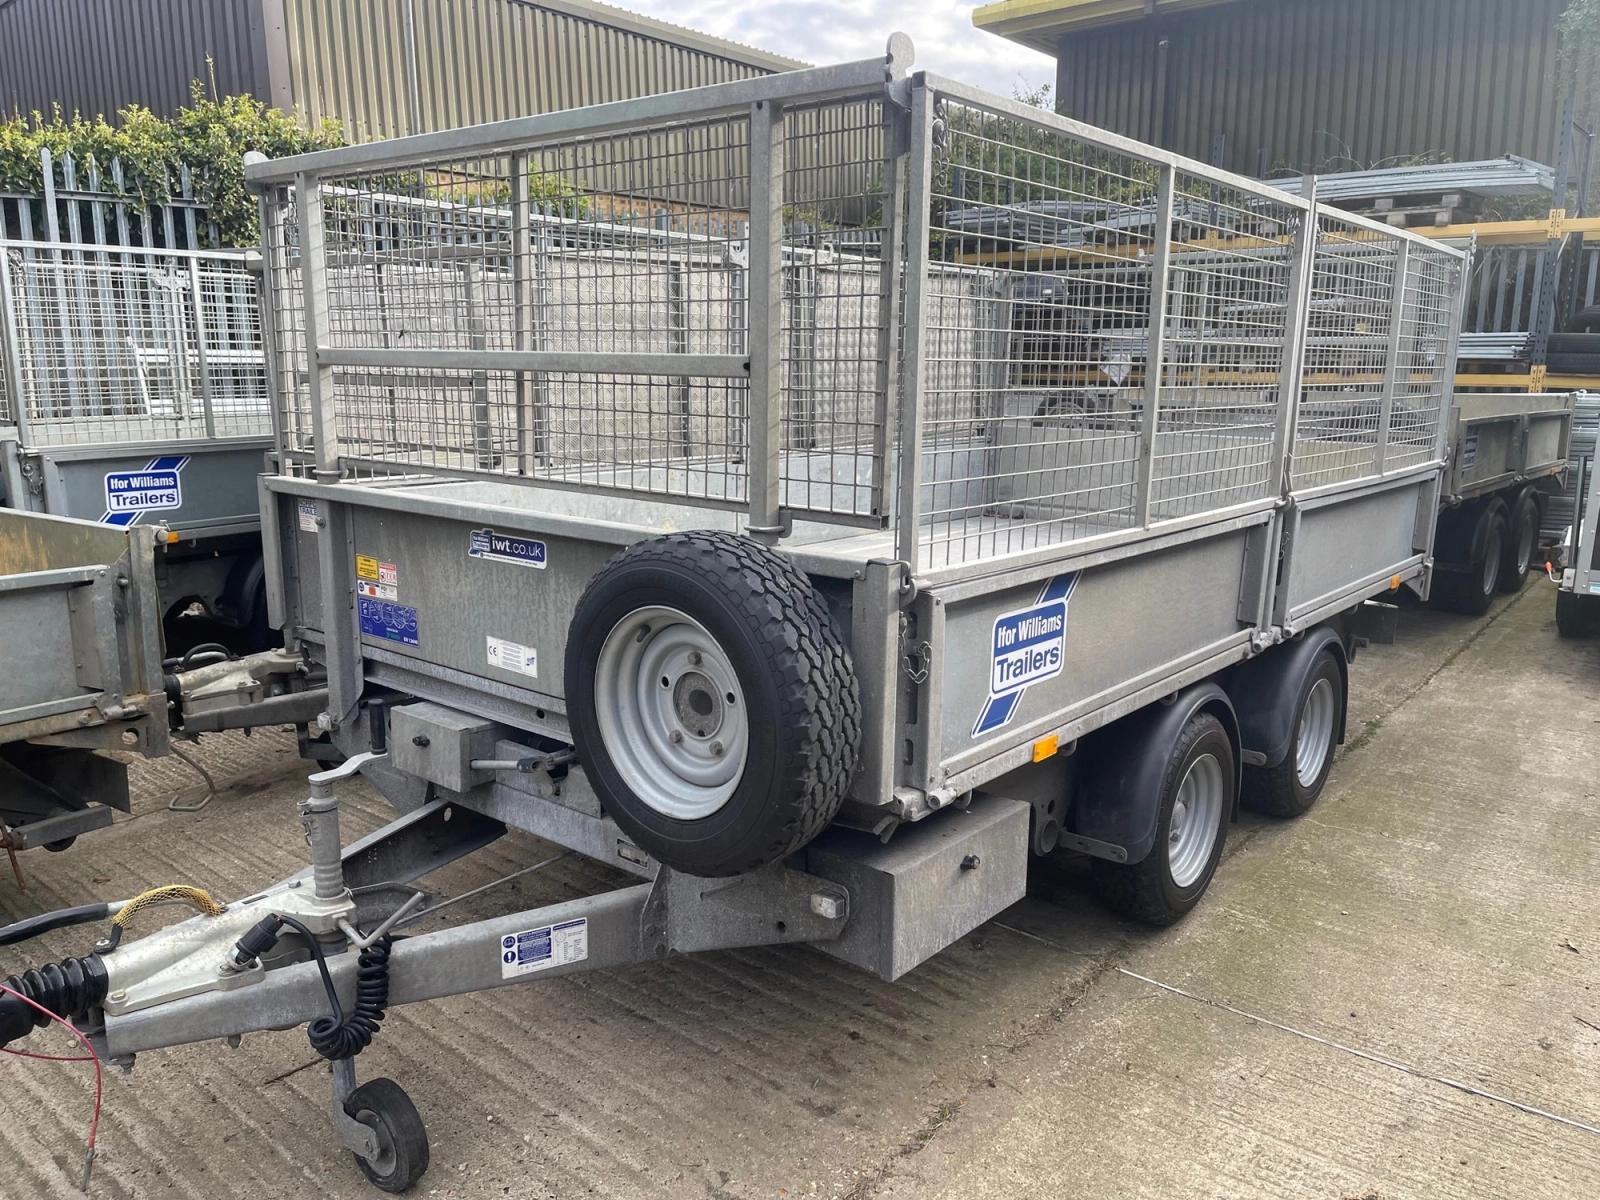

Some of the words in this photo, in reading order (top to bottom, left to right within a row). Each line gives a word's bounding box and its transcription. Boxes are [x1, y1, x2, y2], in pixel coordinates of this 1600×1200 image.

[110, 478, 129, 489] Ifor
[129, 476, 175, 488] Williams
[112, 492, 176, 506] Trailers
[492, 537, 542, 557] iwt.co.uk
[997, 626, 1017, 648] Ifor
[1018, 614, 1062, 641] Williams
[996, 646, 1059, 682] Trailers
